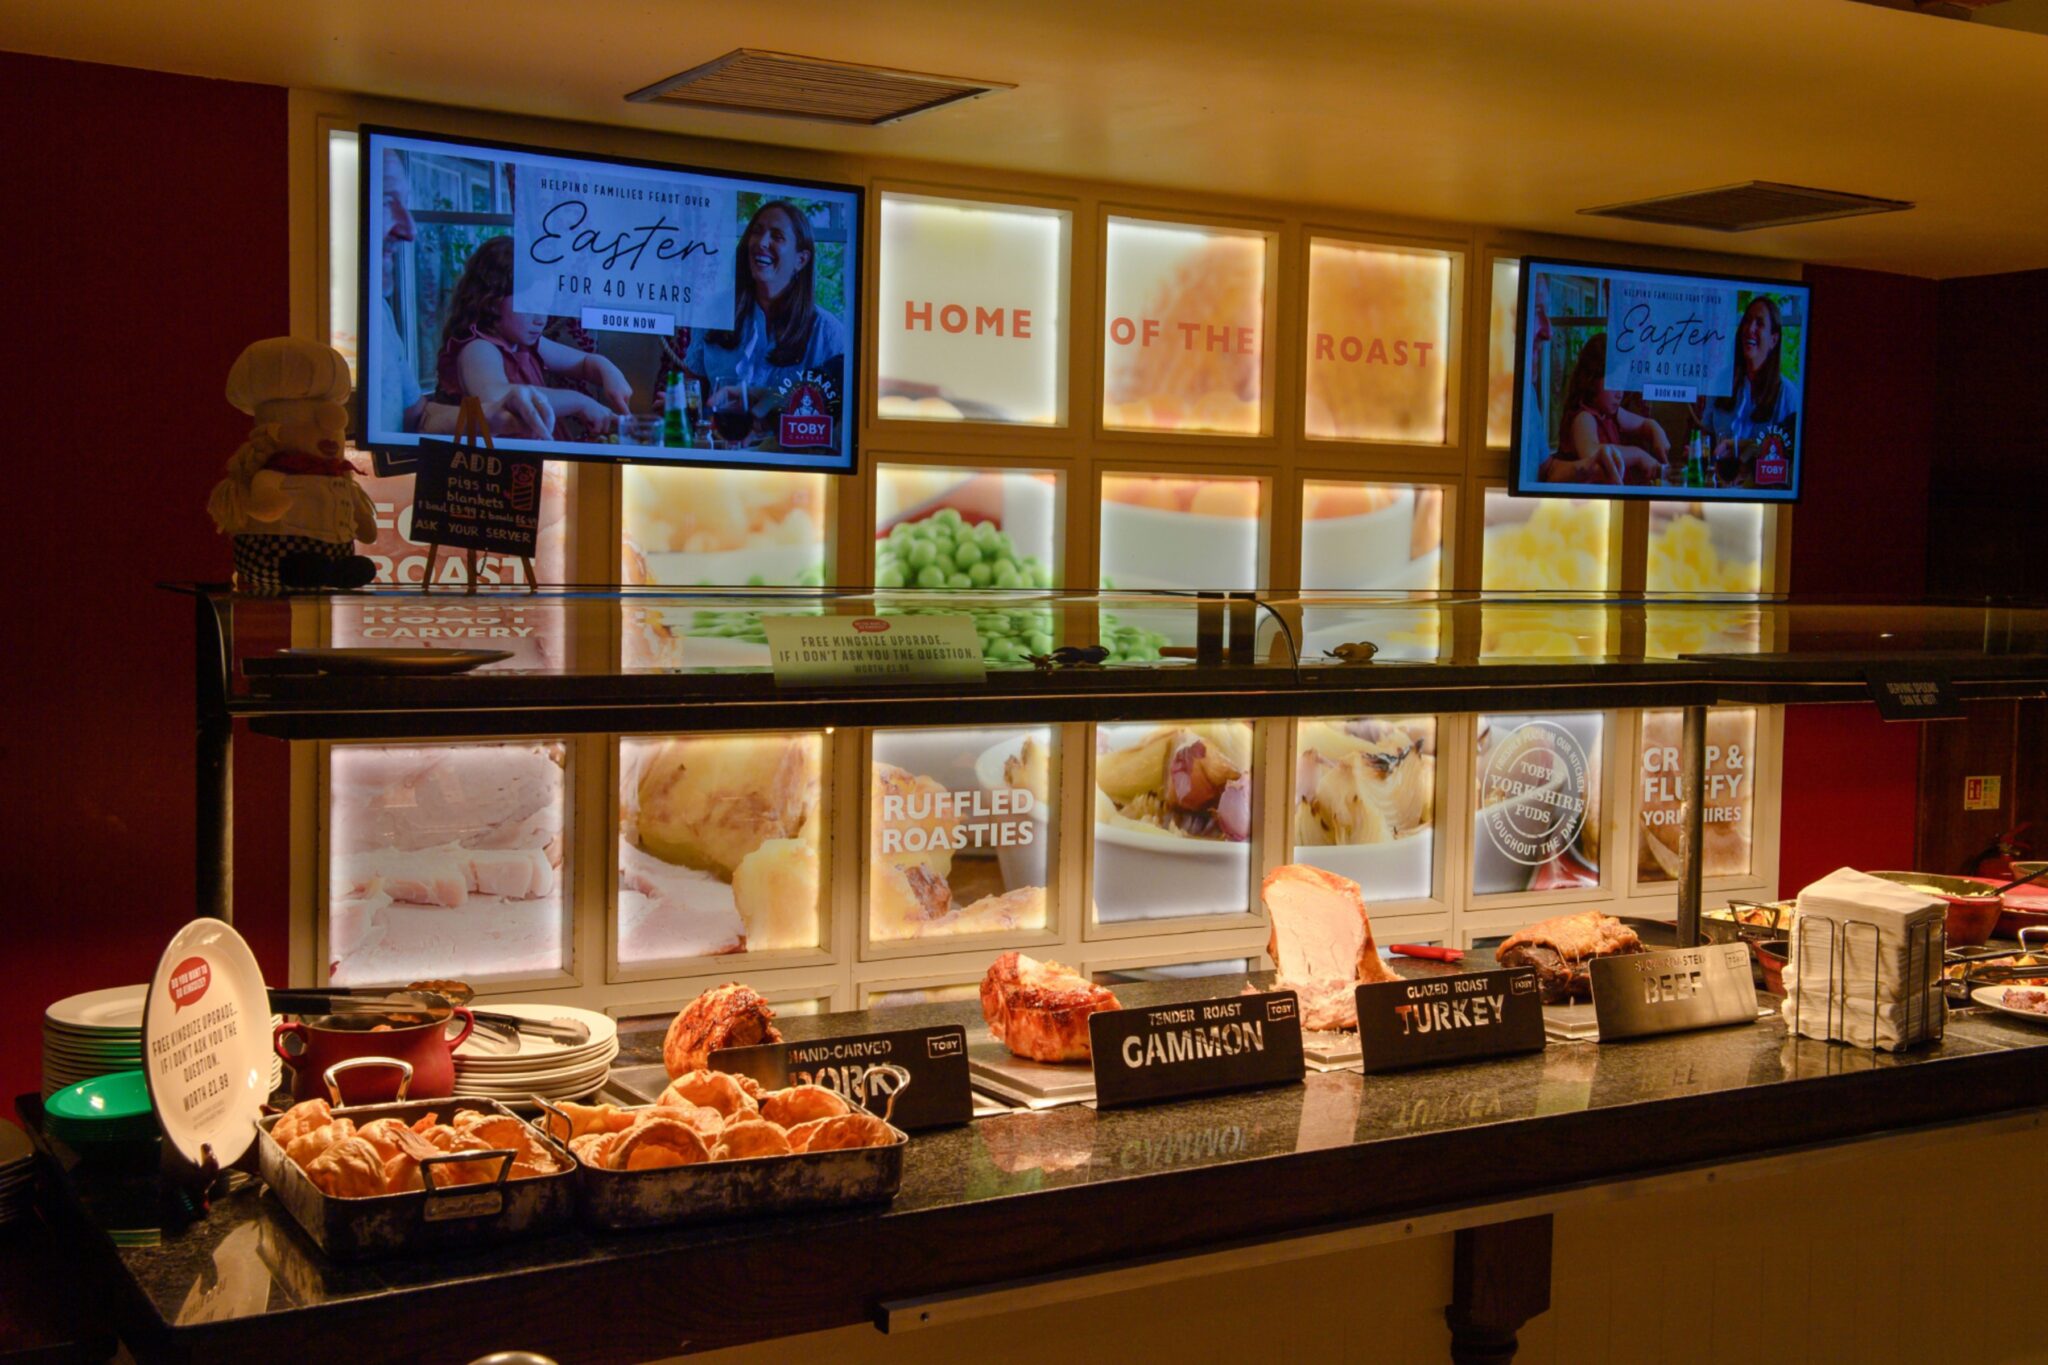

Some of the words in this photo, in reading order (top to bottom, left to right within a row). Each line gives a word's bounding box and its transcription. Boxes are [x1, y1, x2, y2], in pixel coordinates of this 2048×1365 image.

[541, 178, 588, 194] HELPING
[594, 184, 643, 200] FAMILIES
[649, 191, 679, 204] FEAST
[685, 195, 711, 208] OVER
[530, 200, 719, 271] Easter
[559, 275, 591, 295] FOR
[603, 279, 626, 298] 40
[637, 282, 692, 304] YEARS
[603, 314, 629, 327] BOOK
[634, 317, 656, 329] NOW
[905, 301, 1032, 340] HOME
[1616, 304, 1725, 355] Easter
[1110, 316, 1160, 347] OF
[1178, 322, 1254, 355] THE
[1315, 332, 1433, 368] ROAST
[1631, 360, 1649, 375] FOR
[1656, 362, 1669, 376] 40
[1676, 363, 1708, 378] YEARS
[778, 377, 792, 395] 40
[796, 370, 836, 399] YEARS
[788, 422, 826, 435] TOBY
[450, 451, 502, 476] ADD
[1761, 465, 1784, 474] TOBY
[447, 491, 504, 509] blankets
[486, 482, 500, 493] in
[416, 519, 438, 530] ASK
[448, 523, 479, 536] YOUR
[486, 528, 531, 543] SERVER
[363, 627, 534, 638] CARVERY
[801, 636, 829, 647] FREE
[833, 635, 887, 647] KINGSIZE
[780, 651, 791, 663] IF
[804, 650, 838, 662] DON'T
[842, 650, 863, 661] ASK
[867, 650, 889, 660] YOU
[894, 649, 915, 660] THE
[918, 648, 976, 660] QUESTION.
[1557, 737, 1573, 755] OUR
[1644, 745, 1720, 772] CRP
[1726, 744, 1744, 769] &
[1490, 775, 1585, 812] YORKSHIRE
[1645, 774, 1743, 802] FLFY
[884, 788, 1034, 822] RUFFLED
[1515, 803, 1551, 823] PUDS
[1643, 806, 1741, 826] YORIRES
[882, 821, 1033, 854] ROASTIES
[1490, 811, 1538, 856] ROUGHOUT
[1540, 836, 1561, 856] THE
[1561, 815, 1577, 840] DAY
[1407, 983, 1448, 998] GLAZED
[1455, 978, 1488, 993] ROAST
[1643, 971, 1703, 1004] BEEF
[1149, 1009, 1196, 1026] TENDER
[1203, 1003, 1242, 1019] ROAST
[1271, 1005, 1292, 1014] TOBY
[1395, 994, 1504, 1035] TURKEY
[152, 1035, 170, 1057] FREE
[171, 1018, 202, 1047] KINGSIZE
[161, 1058, 168, 1075] IF
[173, 1044, 192, 1068] DON'T
[194, 1036, 207, 1055] ASK
[208, 1028, 223, 1047] YOU
[224, 1020, 237, 1039] THE
[932, 1040, 958, 1051] TOBY
[1122, 1020, 1264, 1068] GAMMON
[789, 1040, 892, 1064] HAND-CARVED
[183, 1086, 207, 1112] WORTH
[208, 1073, 229, 1096] £1.99
